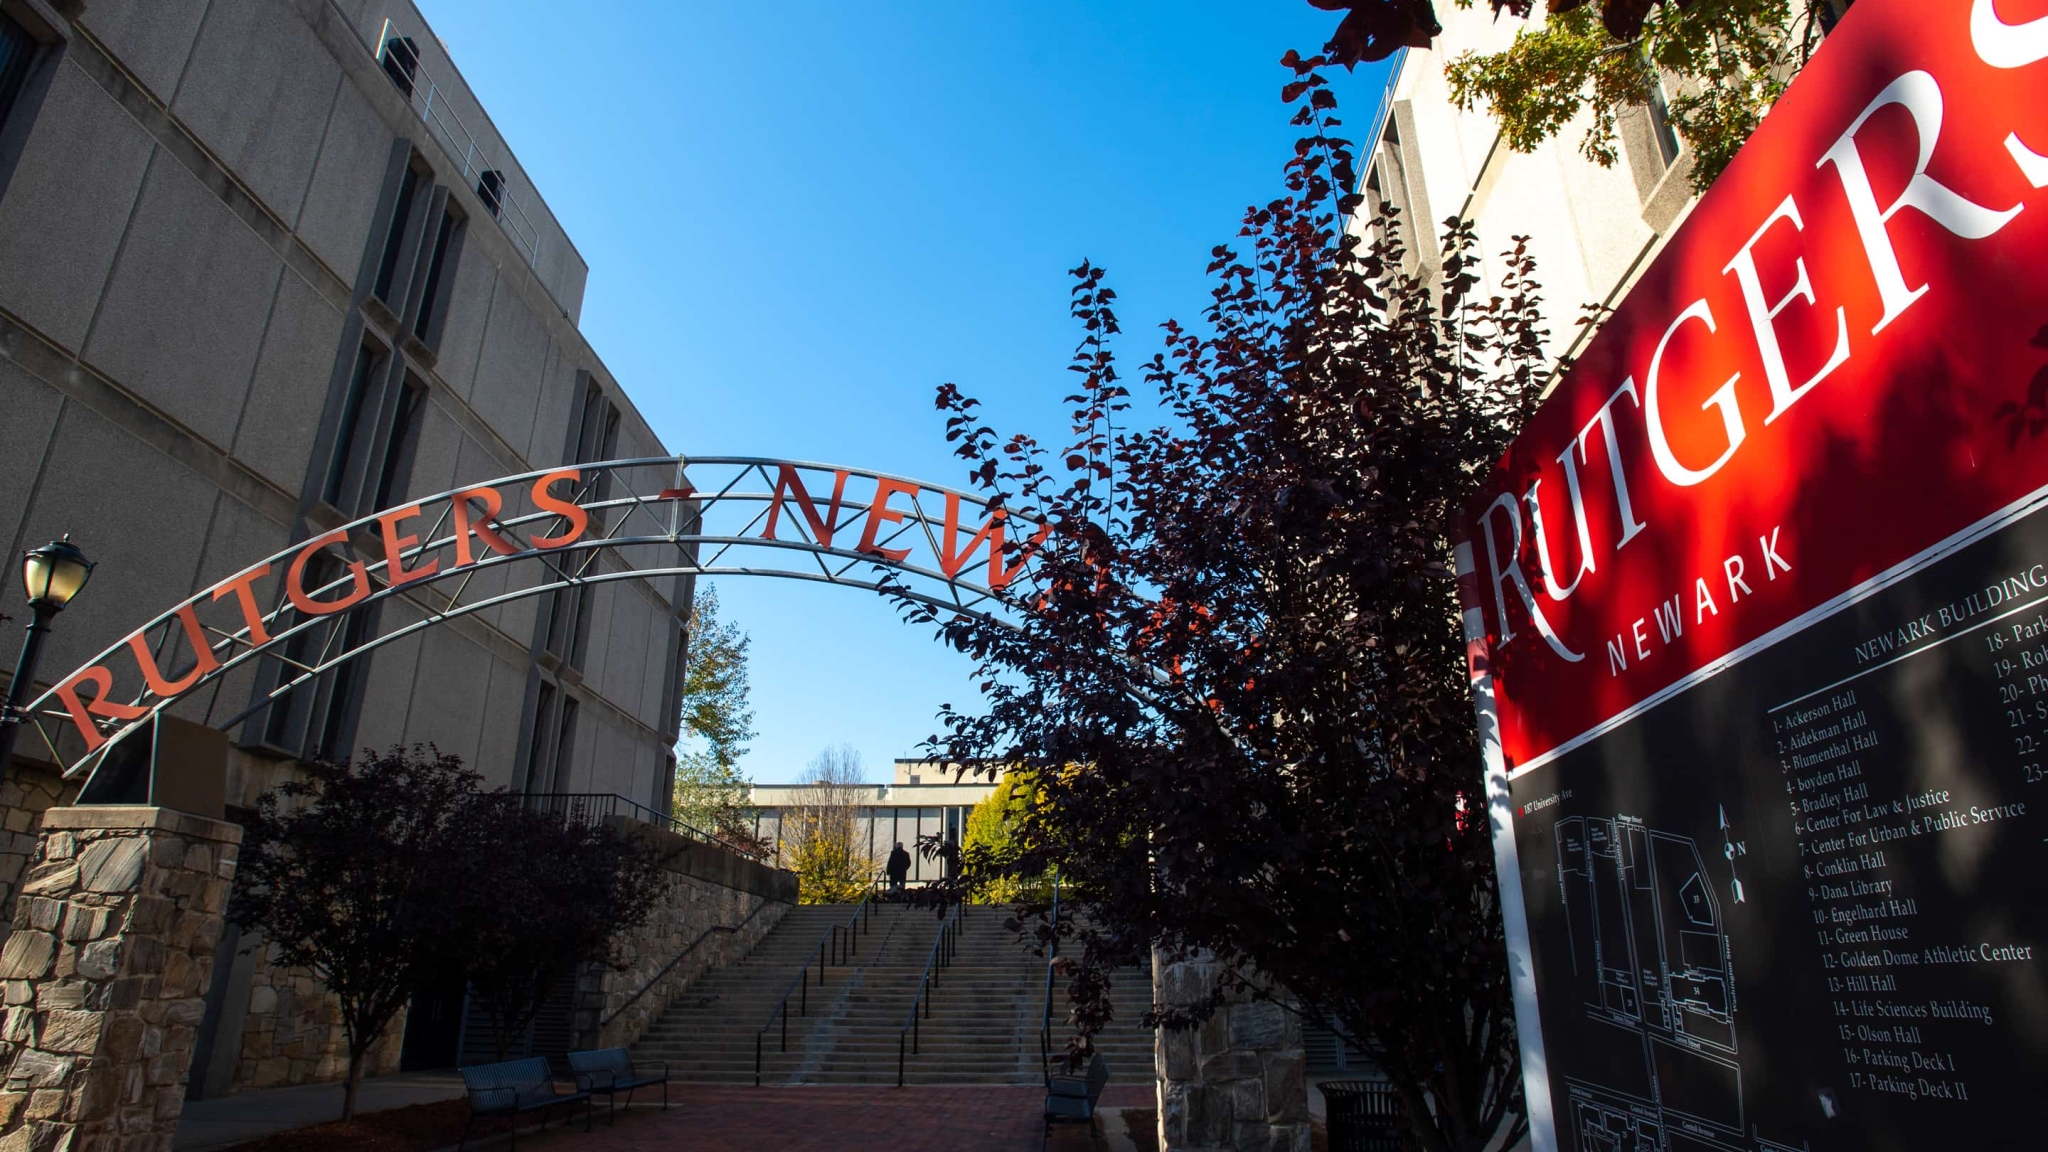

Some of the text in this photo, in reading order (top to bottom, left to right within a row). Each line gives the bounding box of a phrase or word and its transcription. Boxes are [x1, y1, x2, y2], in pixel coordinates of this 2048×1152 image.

[56, 469, 589, 753] RUTGERS
[1607, 525, 1793, 677] NEWARK
[1854, 614, 1936, 664] NEWARK
[1986, 632, 2009, 652] 18-
[1993, 659, 2017, 678] 19-
[1999, 683, 2025, 704] 20-
[1773, 690, 1857, 733] 1- Ackerson Hall
[2007, 700, 2048, 728] 21- S
[1777, 710, 1867, 754] 2- Aidekman Hall
[2015, 735, 2041, 755] 22-
[1781, 730, 1879, 774] 3- Blumenthal Hall
[1786, 781, 1796, 795] 4-
[1836, 760, 1862, 780] Hall
[2023, 763, 2048, 783] 23-
[1533, 793, 1560, 811] University
[1790, 783, 1869, 816] 5- Bradley Hall
[1795, 789, 1950, 835] 6- Center For Law & Justice
[1798, 800, 2027, 857] 7- Center For Urban & Public Service
[1736, 841, 1747, 856] N
[1803, 850, 1887, 879] 8- Conklin Hall
[1808, 878, 1893, 901] 9- Dana Library
[1812, 899, 1917, 927] 10- Engelhard Hall
[1817, 925, 1909, 945] 11- Green House
[1822, 942, 2032, 969] 12- Golden Dome Athletic Center
[1827, 974, 1897, 992] 13- Hill Hall
[1833, 1000, 1992, 1025] 14- Life Sciences Building
[1839, 1025, 1922, 1044] 15- Olson Hall
[1844, 1048, 1956, 1073] 16- Parking Deck I
[1850, 1072, 1969, 1100] 17- Parking Deck II
